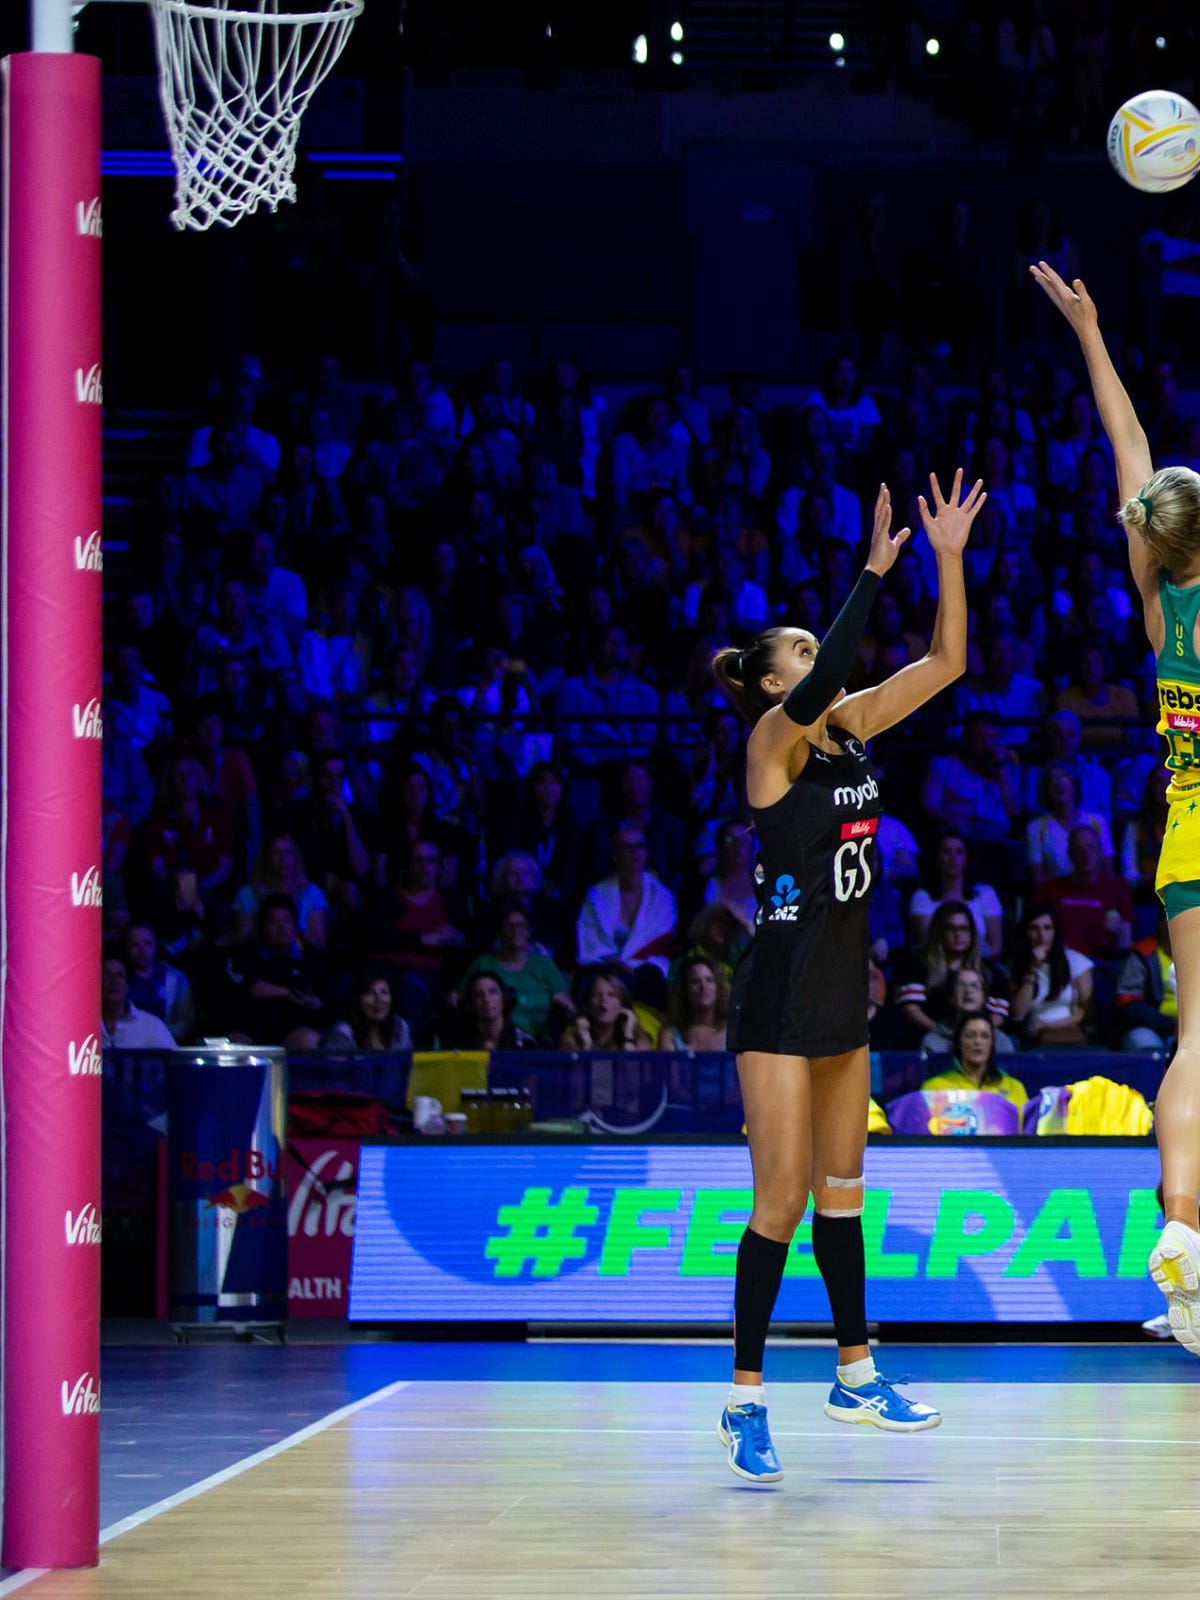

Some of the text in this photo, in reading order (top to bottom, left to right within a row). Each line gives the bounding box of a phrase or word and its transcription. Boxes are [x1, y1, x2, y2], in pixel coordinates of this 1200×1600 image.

[833, 774, 879, 811] myob
[833, 837, 873, 902] GS
[178, 1147, 240, 1183] Red
